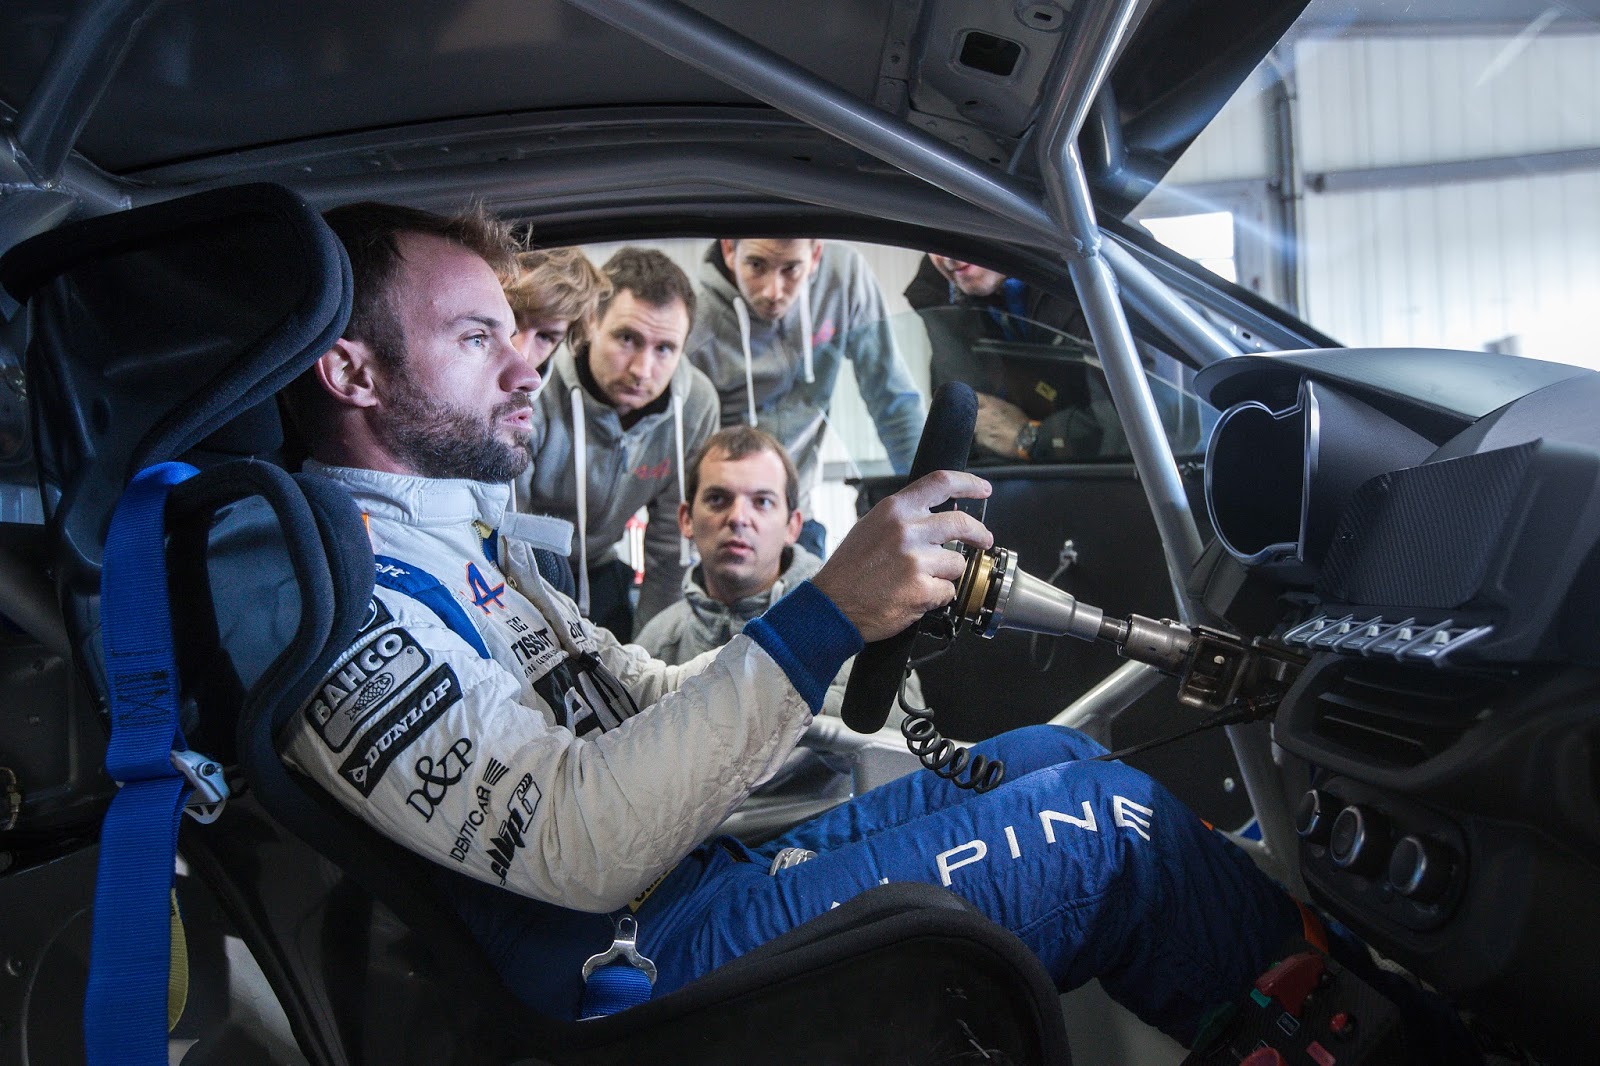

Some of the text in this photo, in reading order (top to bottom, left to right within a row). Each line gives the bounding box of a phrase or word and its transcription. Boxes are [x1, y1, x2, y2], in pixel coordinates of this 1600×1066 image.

[314, 634, 403, 726] BAHCO
[364, 677, 452, 769] DUNLOP
[405, 737, 474, 824] D&P
[449, 785, 492, 863] IDENTICAR
